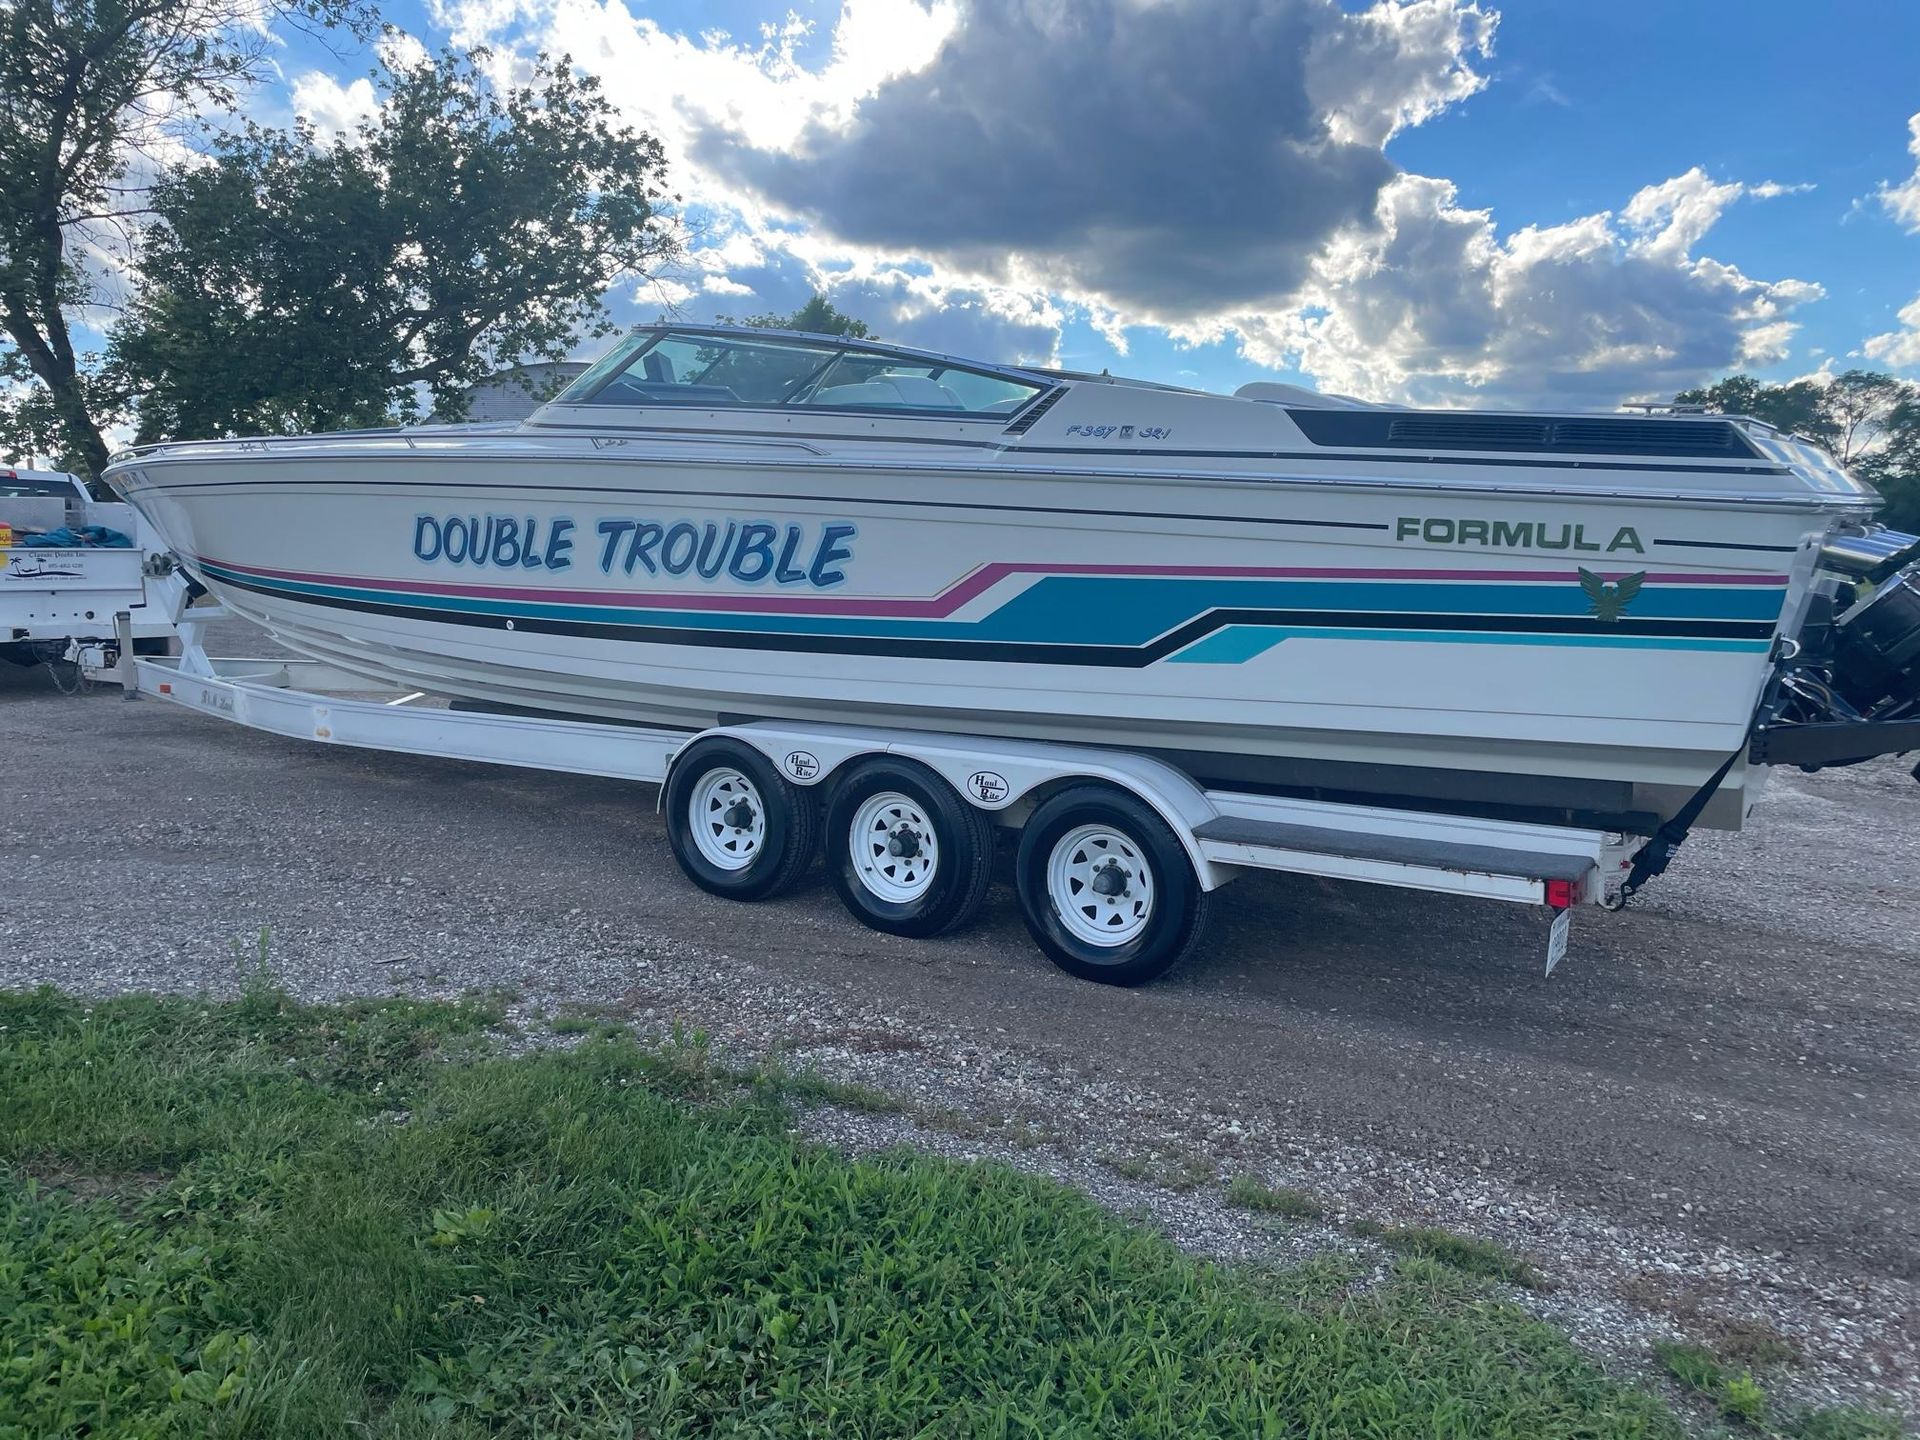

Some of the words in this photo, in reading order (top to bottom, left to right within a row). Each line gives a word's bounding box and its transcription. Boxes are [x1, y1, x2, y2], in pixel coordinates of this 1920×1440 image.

[1396, 517, 1645, 554] FORMULA
[412, 514, 576, 572] DOUBLE
[597, 518, 858, 589] TROUBLE
[791, 754, 811, 767] Haul
[795, 766, 813, 777] Rite
[975, 774, 998, 787] Haul
[980, 787, 1000, 800] Rite
